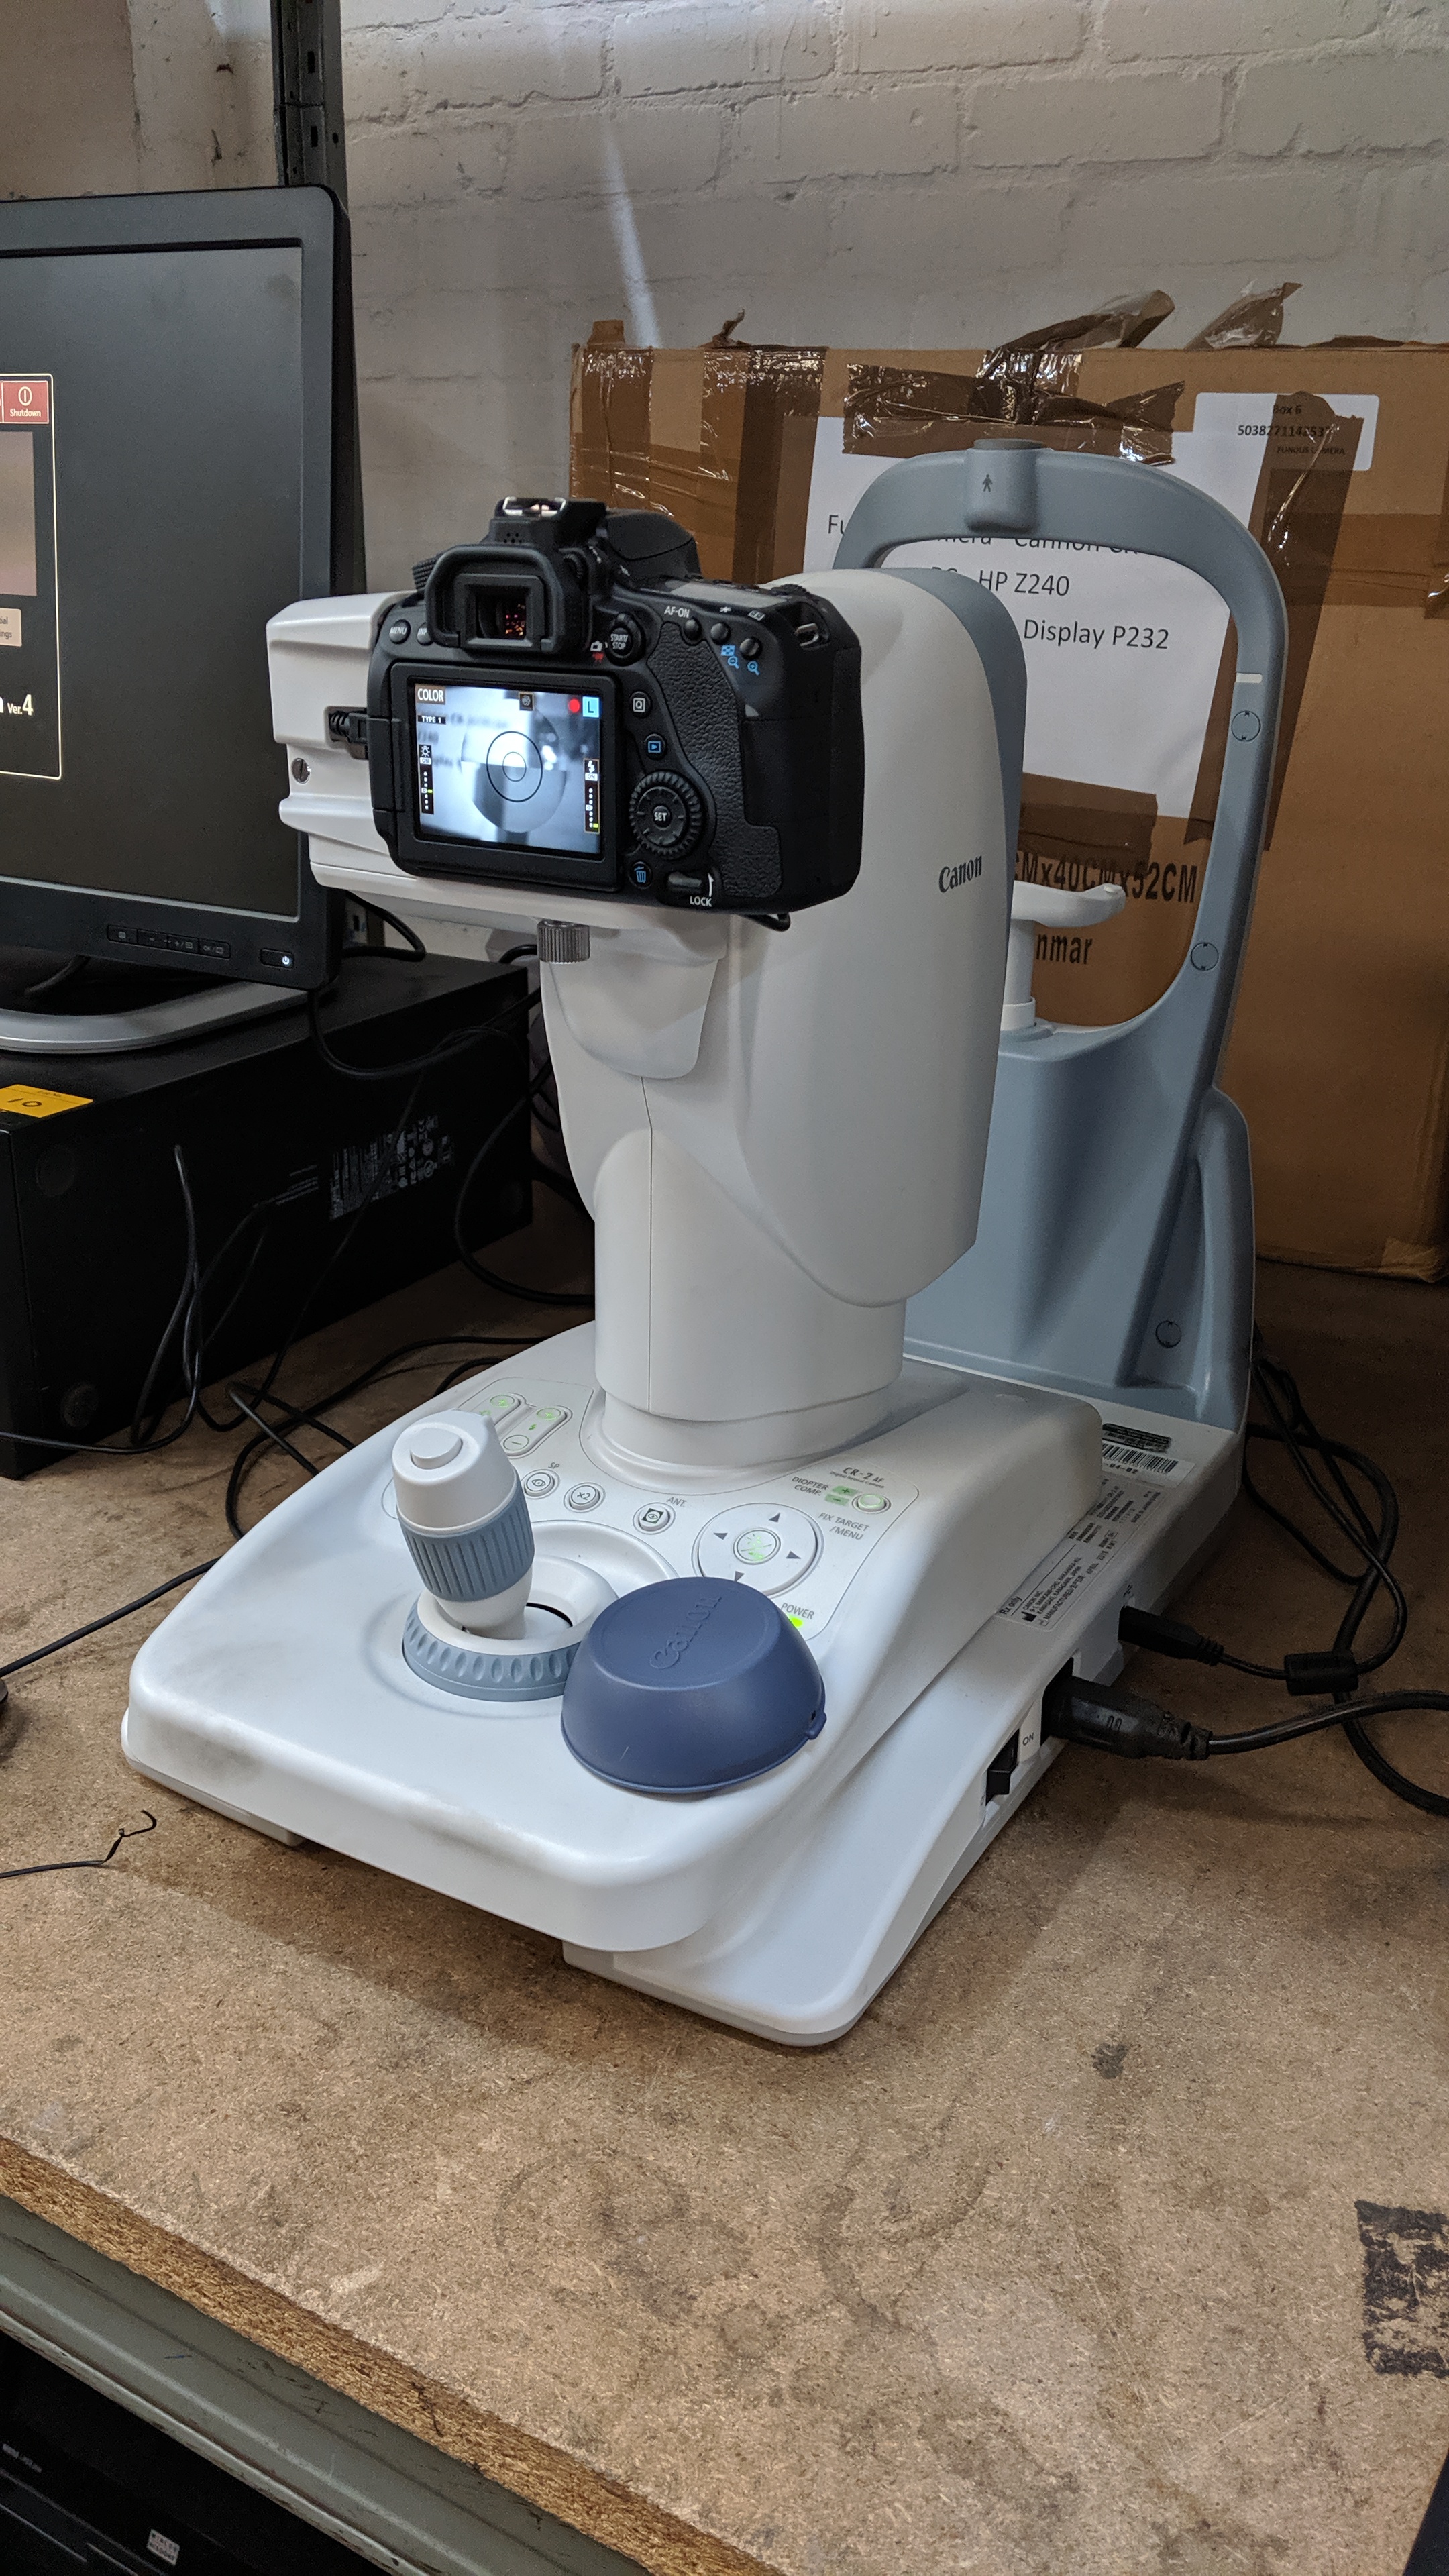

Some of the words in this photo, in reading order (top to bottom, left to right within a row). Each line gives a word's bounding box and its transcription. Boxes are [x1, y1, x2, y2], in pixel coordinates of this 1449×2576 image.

[10, 408, 42, 417] Shutdown
[979, 570, 1008, 592] HP
[1014, 572, 1071, 596] Z240
[664, 606, 690, 618] AF-ON
[389, 626, 408, 635] MENU
[1023, 619, 1105, 647] Display
[1112, 625, 1169, 650] P232
[612, 641, 626, 651] STOP
[417, 688, 444, 702] COLOR
[421, 715, 436, 723] TYPE
[654, 812, 667, 821] SET
[939, 855, 982, 893] Canon
[690, 896, 712, 907] LOCK
[547, 1462, 560, 1470] SP
[792, 1476, 829, 1491] DIOPTER
[794, 1484, 822, 1497] COMP.
[818, 1513, 835, 1522] FIX
[835, 1517, 870, 1532] TARGET
[829, 1525, 864, 1540] /MENU
[781, 1602, 815, 1621] POWER
[649, 1596, 722, 1670] Canon
[1022, 1732, 1034, 1746] ON
